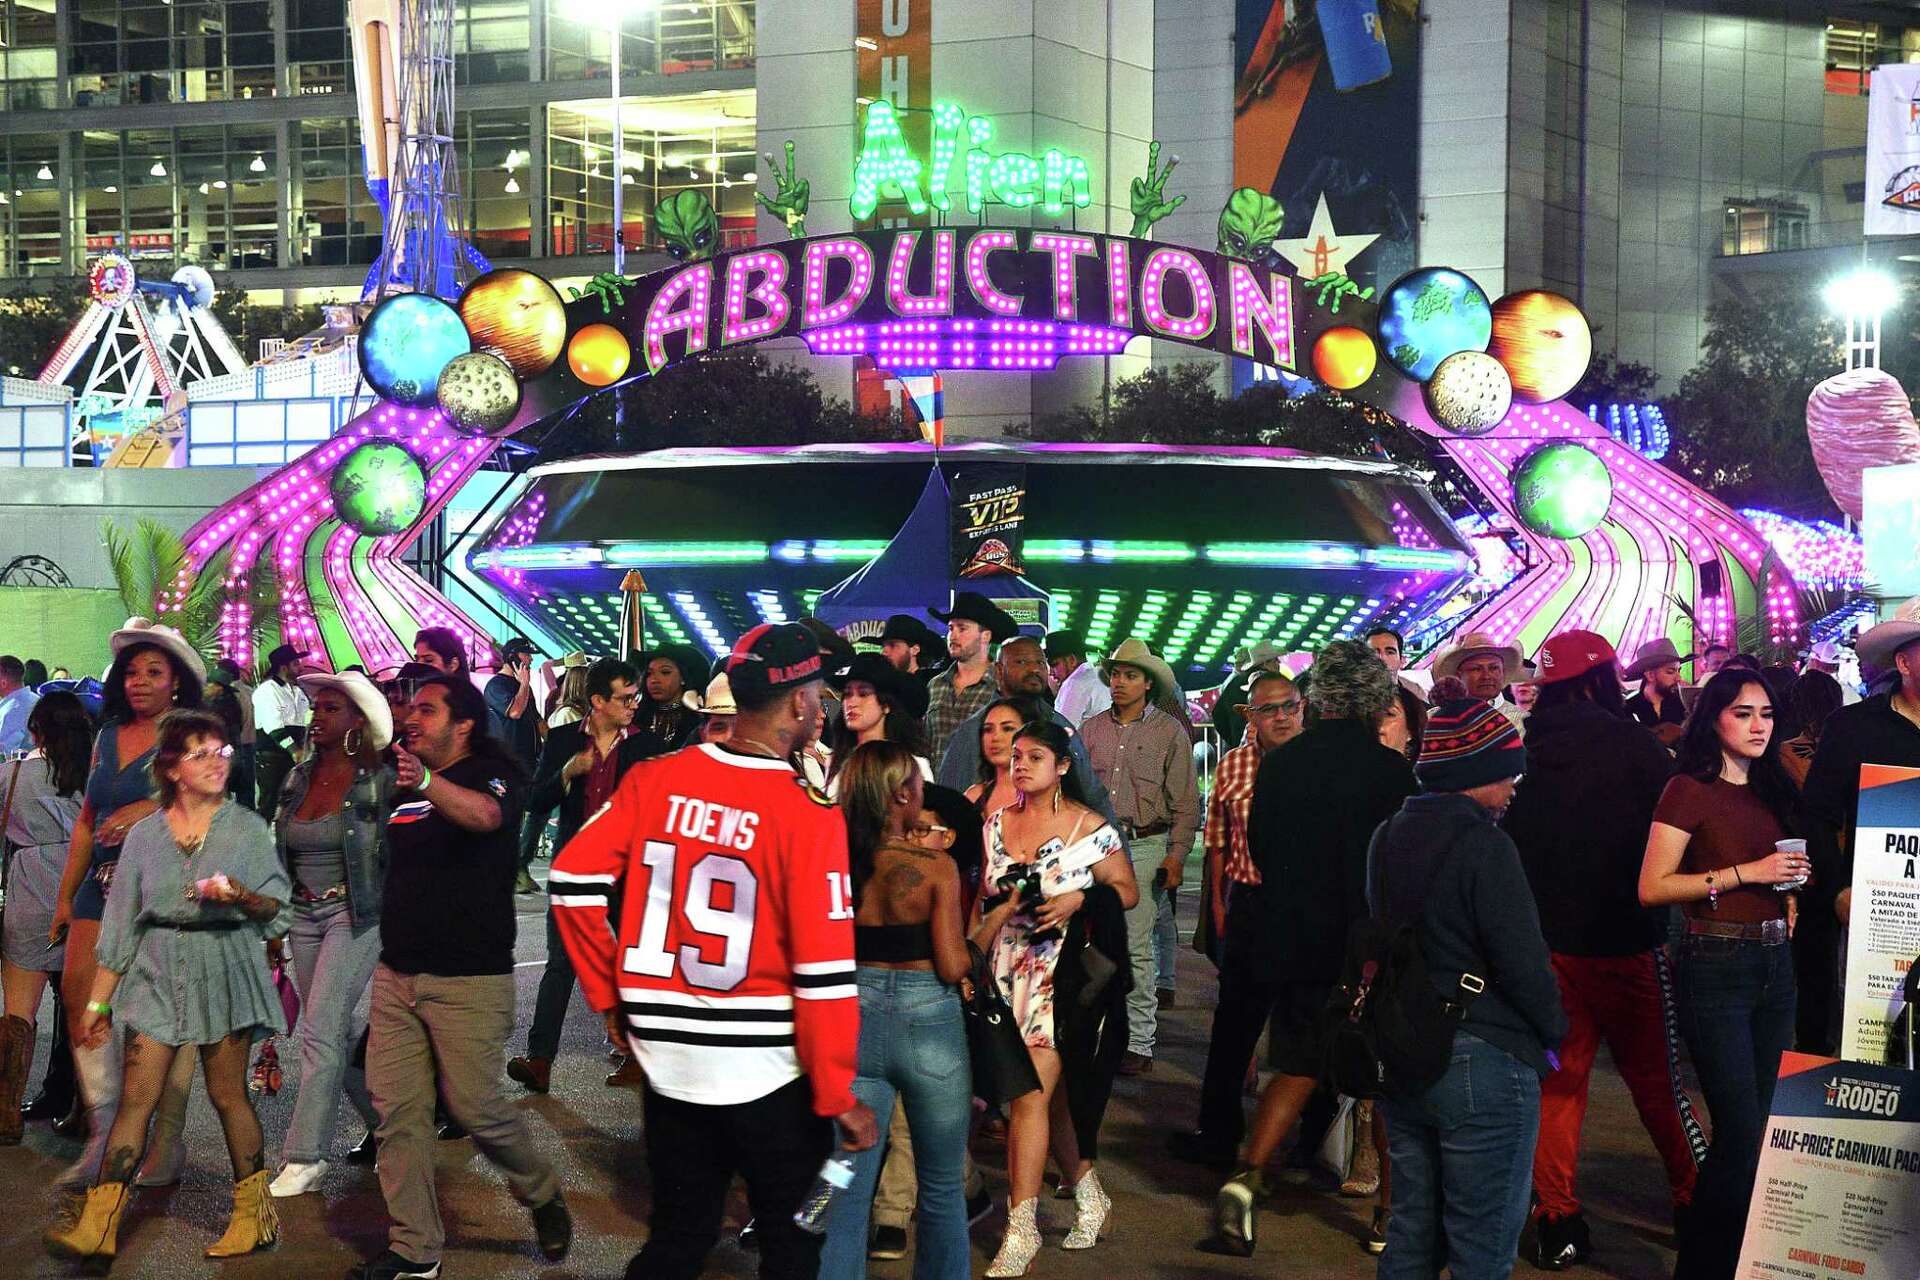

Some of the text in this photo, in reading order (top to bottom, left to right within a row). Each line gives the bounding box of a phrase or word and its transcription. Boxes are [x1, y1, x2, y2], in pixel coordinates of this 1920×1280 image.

[850, 99, 1090, 219] Alien
[643, 228, 1298, 377] ABDUCTION
[969, 485, 1018, 502] FAST PASS
[970, 497, 1019, 526] VIP
[1000, 521, 1018, 531] LANE
[846, 620, 887, 644] ABDUC
[664, 794, 760, 851] TOEWS
[1884, 832, 1920, 858] PAQ
[1903, 858, 1916, 880] A
[1870, 898, 1916, 909] CARNAVAL
[1887, 890, 1920, 900] PAQUET
[622, 839, 759, 993] 19
[1878, 908, 1905, 918] MITAD
[1907, 911, 1919, 919] DE
[1894, 959, 1913, 972] TAR
[1857, 1037, 1887, 1047] Jóvene
[1858, 1028, 1887, 1037] Adulto
[1835, 1083, 1900, 1117] RODEO
[1769, 1127, 1920, 1174] HALF-PRICE CARNIVAL PAC
[1788, 1247, 1821, 1267] CARNIVAL
